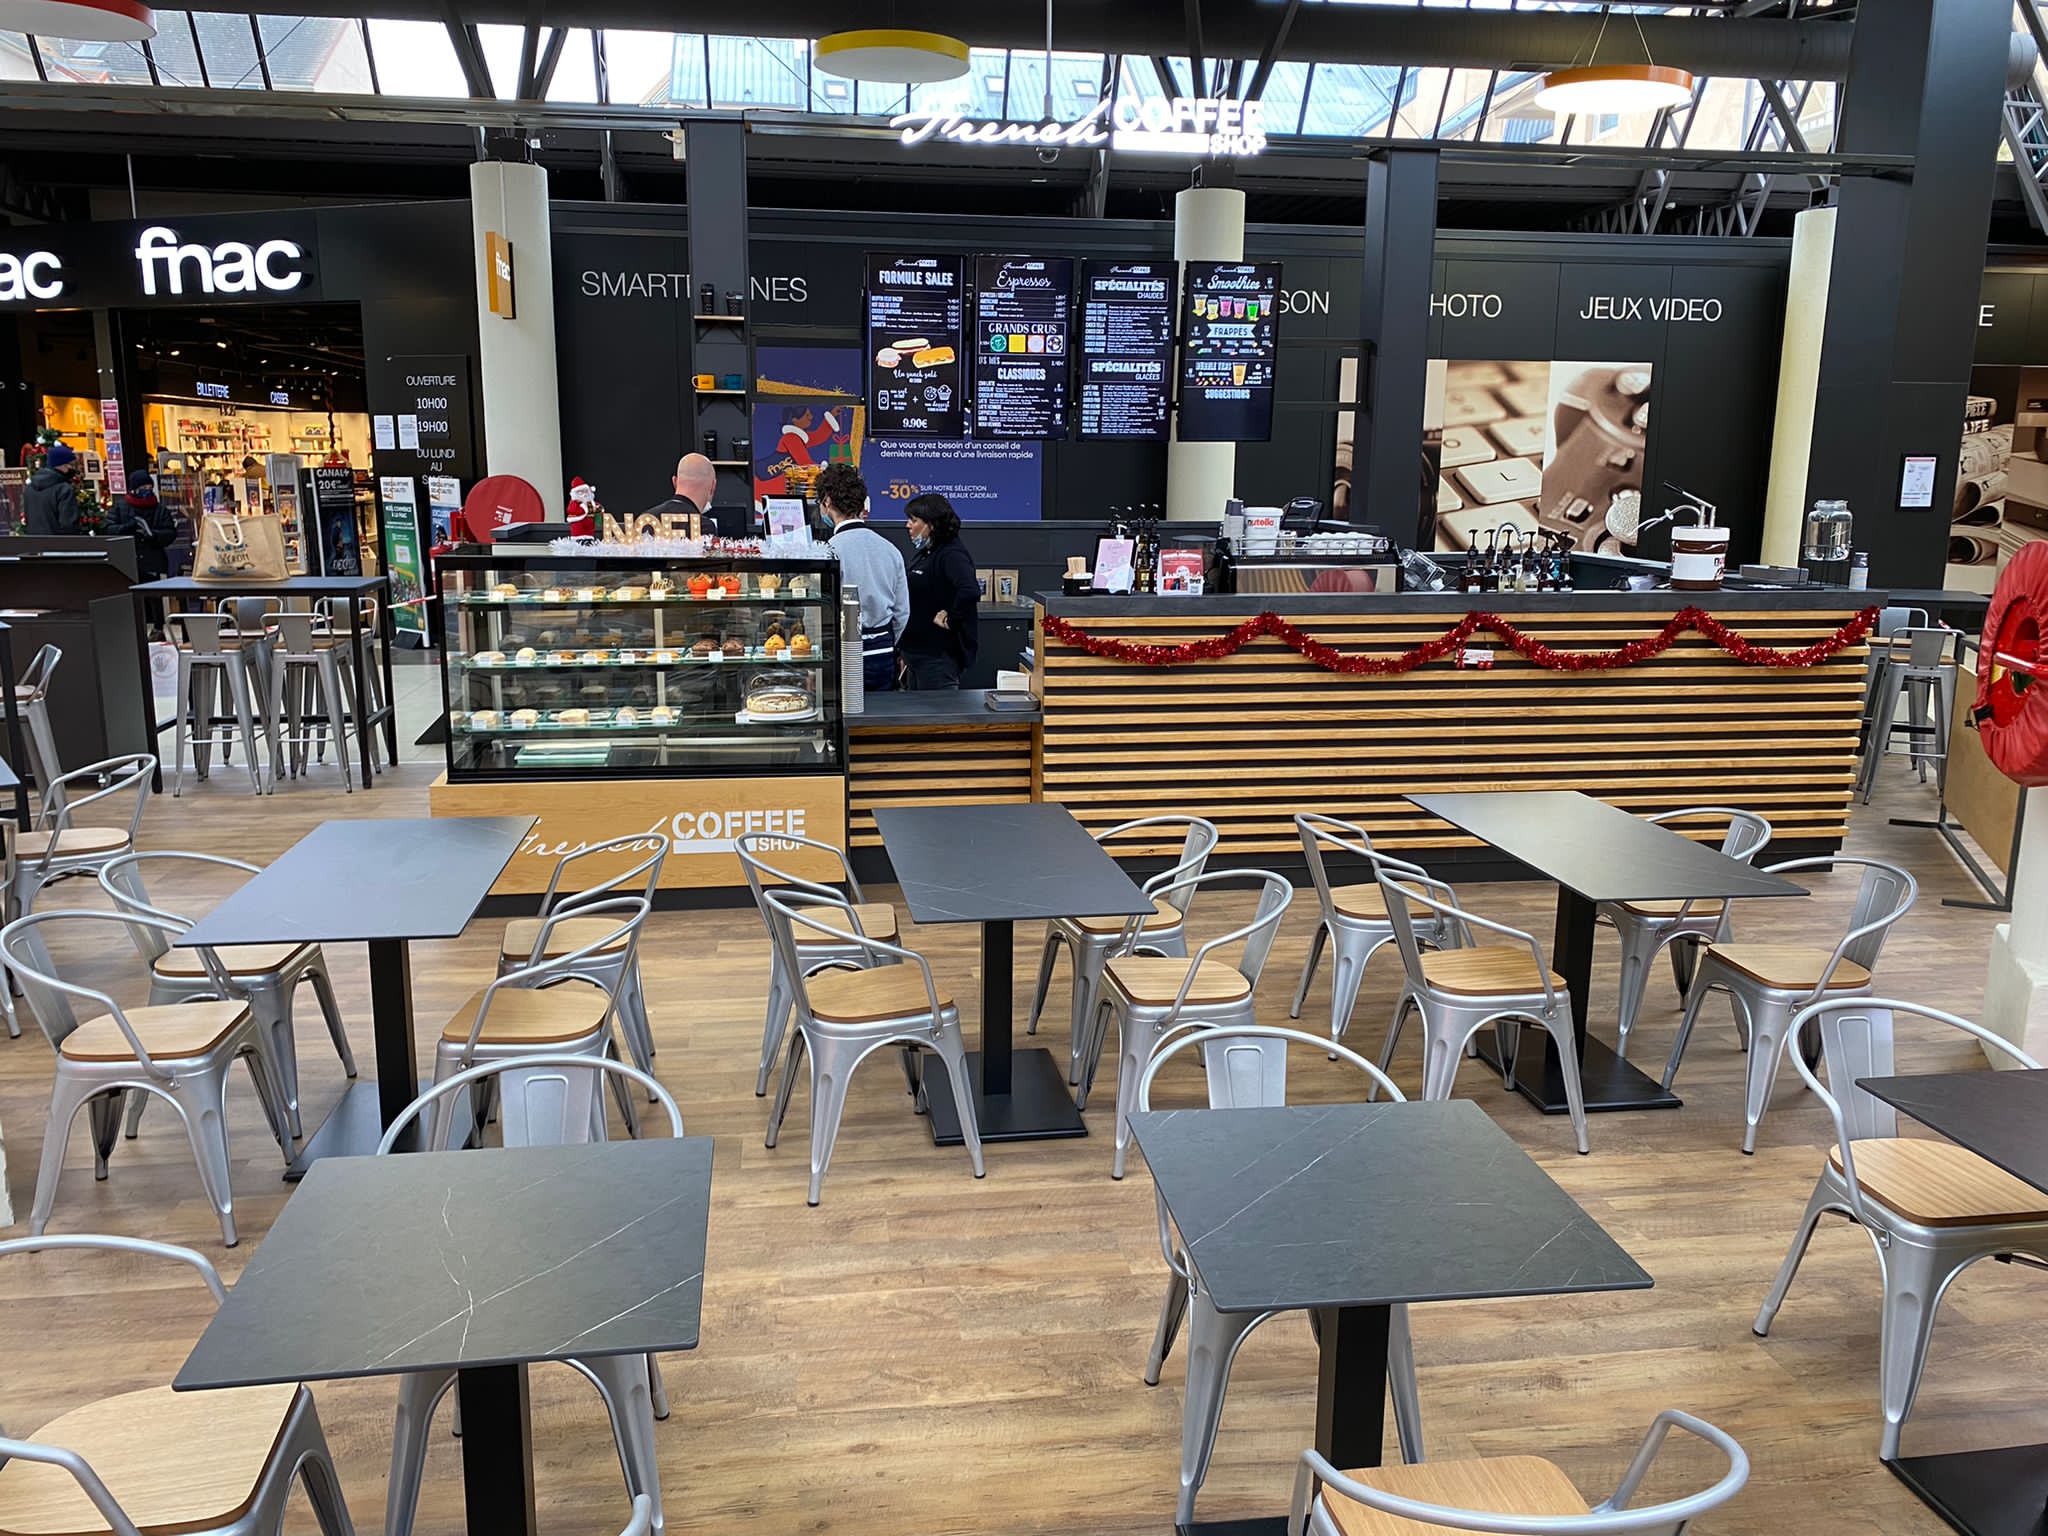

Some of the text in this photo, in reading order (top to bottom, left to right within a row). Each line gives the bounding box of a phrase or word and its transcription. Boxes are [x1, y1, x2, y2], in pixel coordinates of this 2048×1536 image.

[890, 96, 1266, 144] French COFFEE
[1211, 134, 1267, 155] SHOP
[135, 226, 302, 296] fnac
[0, 250, 64, 301] ac
[879, 270, 923, 285] FORMULE
[996, 270, 1052, 291] Espressos
[1207, 274, 1261, 290] Smoothies
[581, 271, 808, 303] SMARTNES
[1094, 279, 1165, 292] SPÉCIALITÉS
[1429, 293, 1503, 318] HOTO
[1580, 295, 1723, 322] JEUX VIDEO
[988, 322, 1057, 334] GRANDS CRUS
[1091, 360, 1161, 373] SPÉCIALITÉS
[997, 367, 1046, 380] CLASSIQUES
[406, 375, 456, 386] OUVERTURE
[1204, 388, 1250, 399] SUGGESTIONS
[416, 397, 447, 409] 10H00
[72, 403, 98, 425] fna
[418, 421, 448, 433] 19H00
[902, 417, 928, 429] 9.90€
[1963, 418, 1990, 434] LIFE
[880, 440, 897, 449] Que
[918, 442, 936, 450] ayez
[937, 440, 963, 449] besoin
[964, 441, 982, 449] d'un
[982, 441, 1009, 450] conseil
[1010, 441, 1021, 449] de
[416, 448, 456, 458] DU LUNDI
[880, 450, 913, 458] dernière
[914, 450, 940, 458] minute
[953, 450, 975, 458] d'une
[976, 450, 1007, 458] livraison
[1008, 450, 1033, 460] rapide
[430, 461, 443, 472] AU
[767, 456, 793, 476] fnac
[316, 468, 350, 478] CANAL+
[954, 483, 987, 492] SÉLECTION
[1247, 518, 1274, 527] nutella
[672, 809, 806, 840] COFFEE
[758, 836, 806, 852] SHOP
